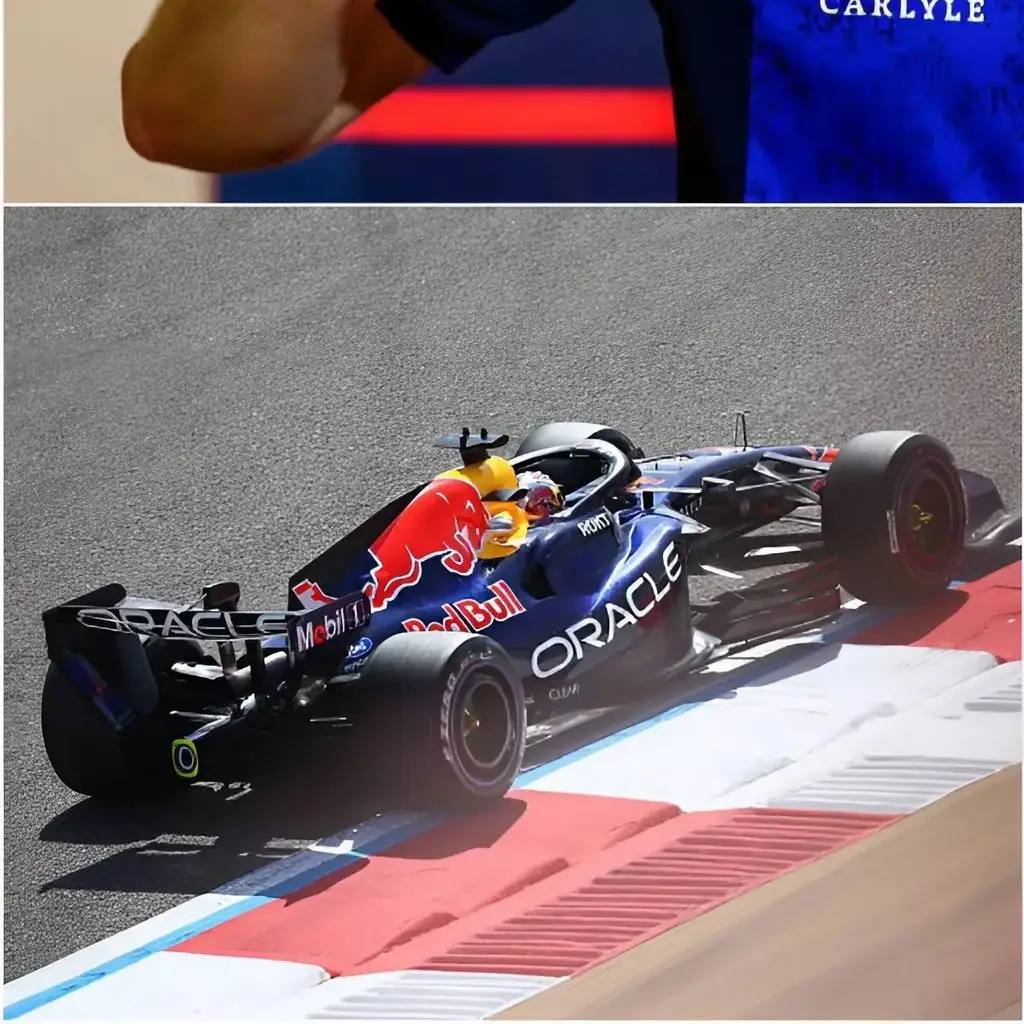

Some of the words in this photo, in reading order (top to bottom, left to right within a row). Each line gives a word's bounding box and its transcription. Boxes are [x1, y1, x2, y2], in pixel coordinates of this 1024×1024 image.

[76, 607, 289, 638] ORACLE
[296, 607, 346, 652] Mobil
[452, 579, 528, 632] Bull
[531, 541, 682, 678] ORACLE
